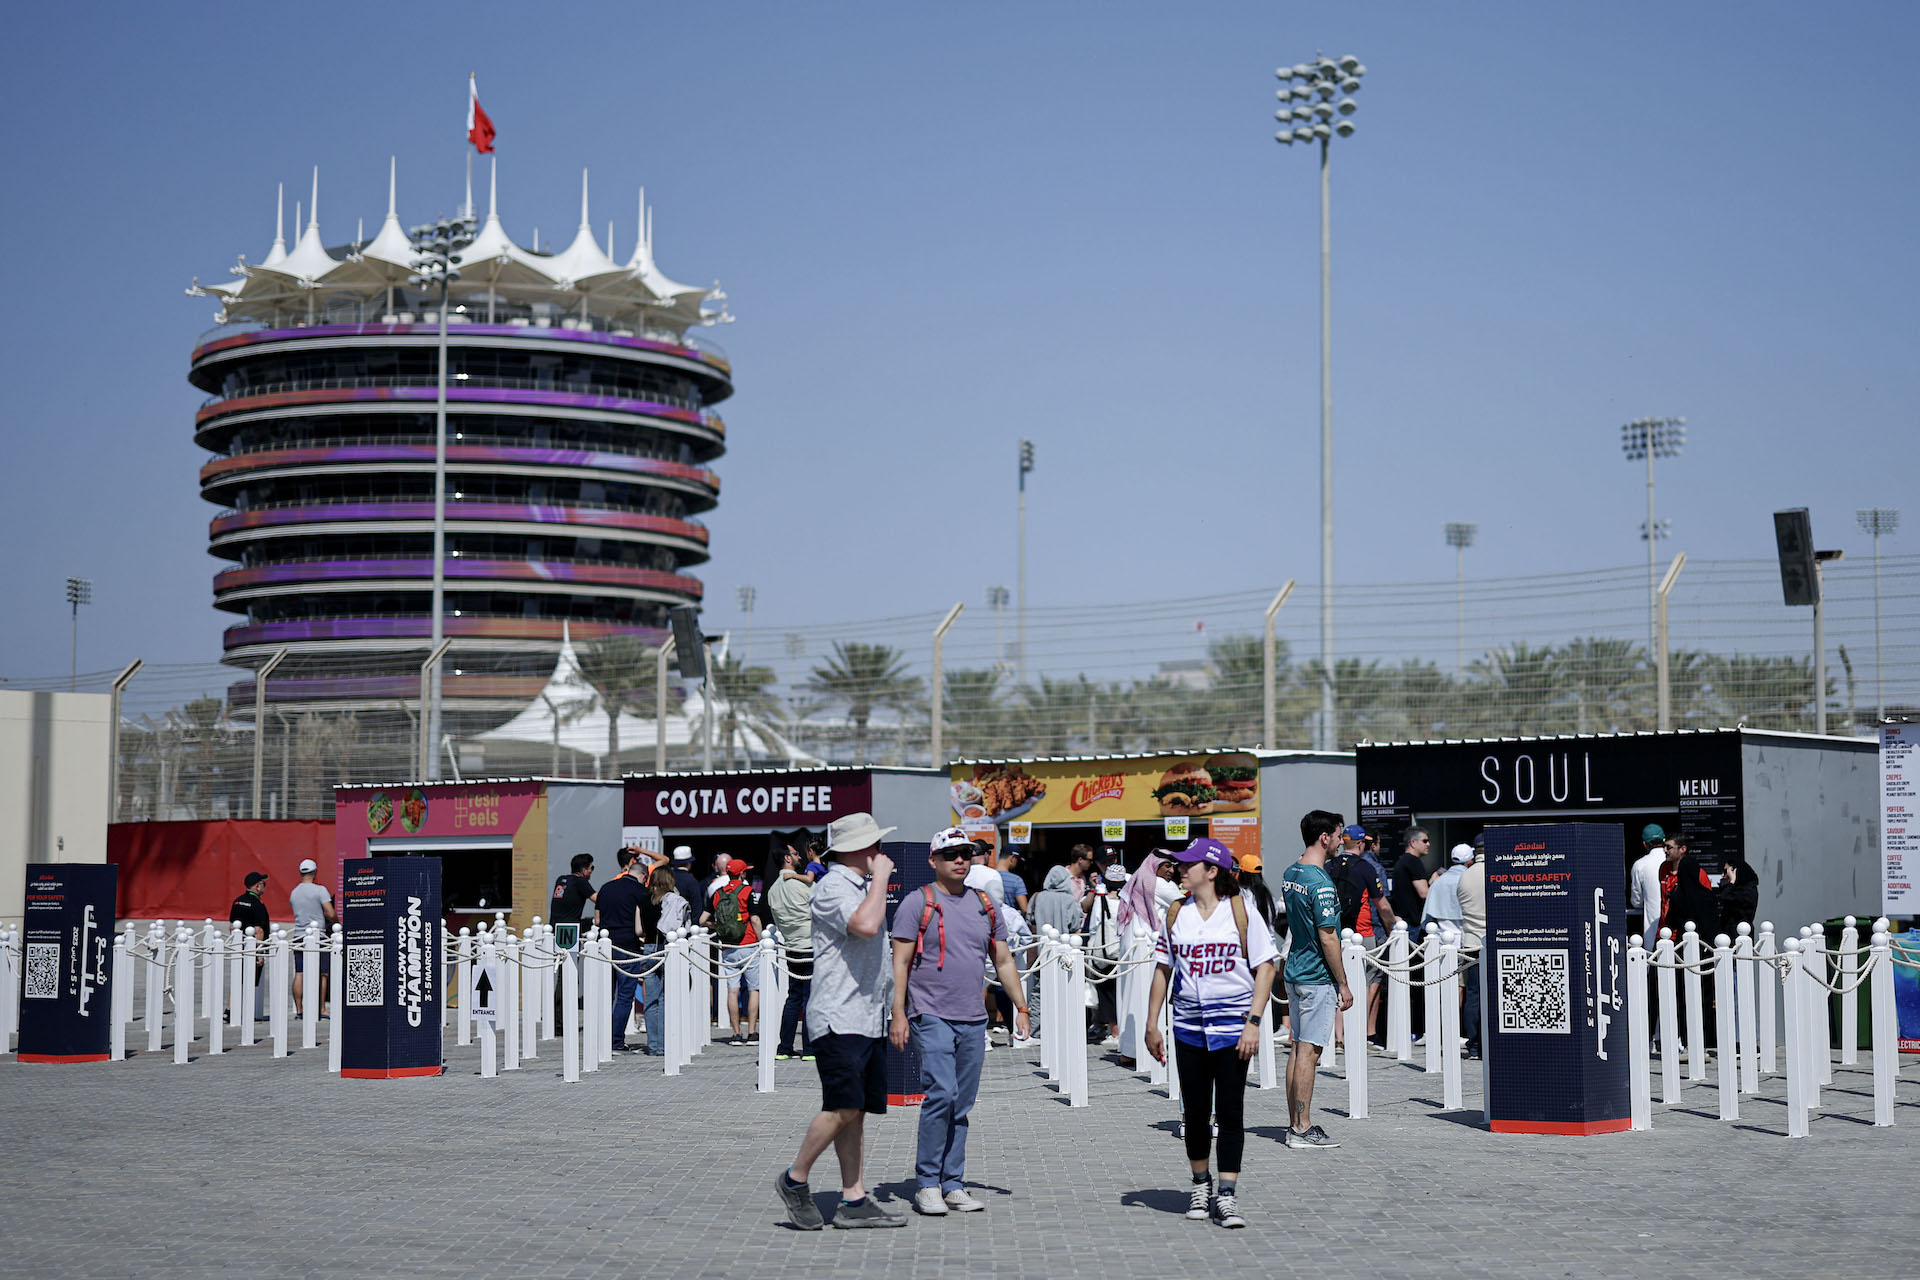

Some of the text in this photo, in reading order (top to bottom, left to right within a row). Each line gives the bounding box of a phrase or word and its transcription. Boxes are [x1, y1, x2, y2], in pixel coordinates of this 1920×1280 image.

[1481, 752, 1603, 804] SOUL
[1680, 779, 1718, 796] MENU
[656, 786, 831, 818] COSTA COFFEE
[1361, 790, 1394, 806] MENU
[1168, 826, 1186, 834] HERE
[1514, 842, 1545, 852] لسلامتكم
[1510, 874, 1534, 882] YOUR
[1536, 873, 1571, 881] SAFETY
[560, 928, 573, 944] IN
[1172, 943, 1237, 958] PUERTO
[408, 896, 421, 1027] CHAMPION
[1190, 960, 1235, 977] RICO
[1587, 996, 1594, 1007] 5
[1898, 1040, 1920, 1049] LECTRIC
